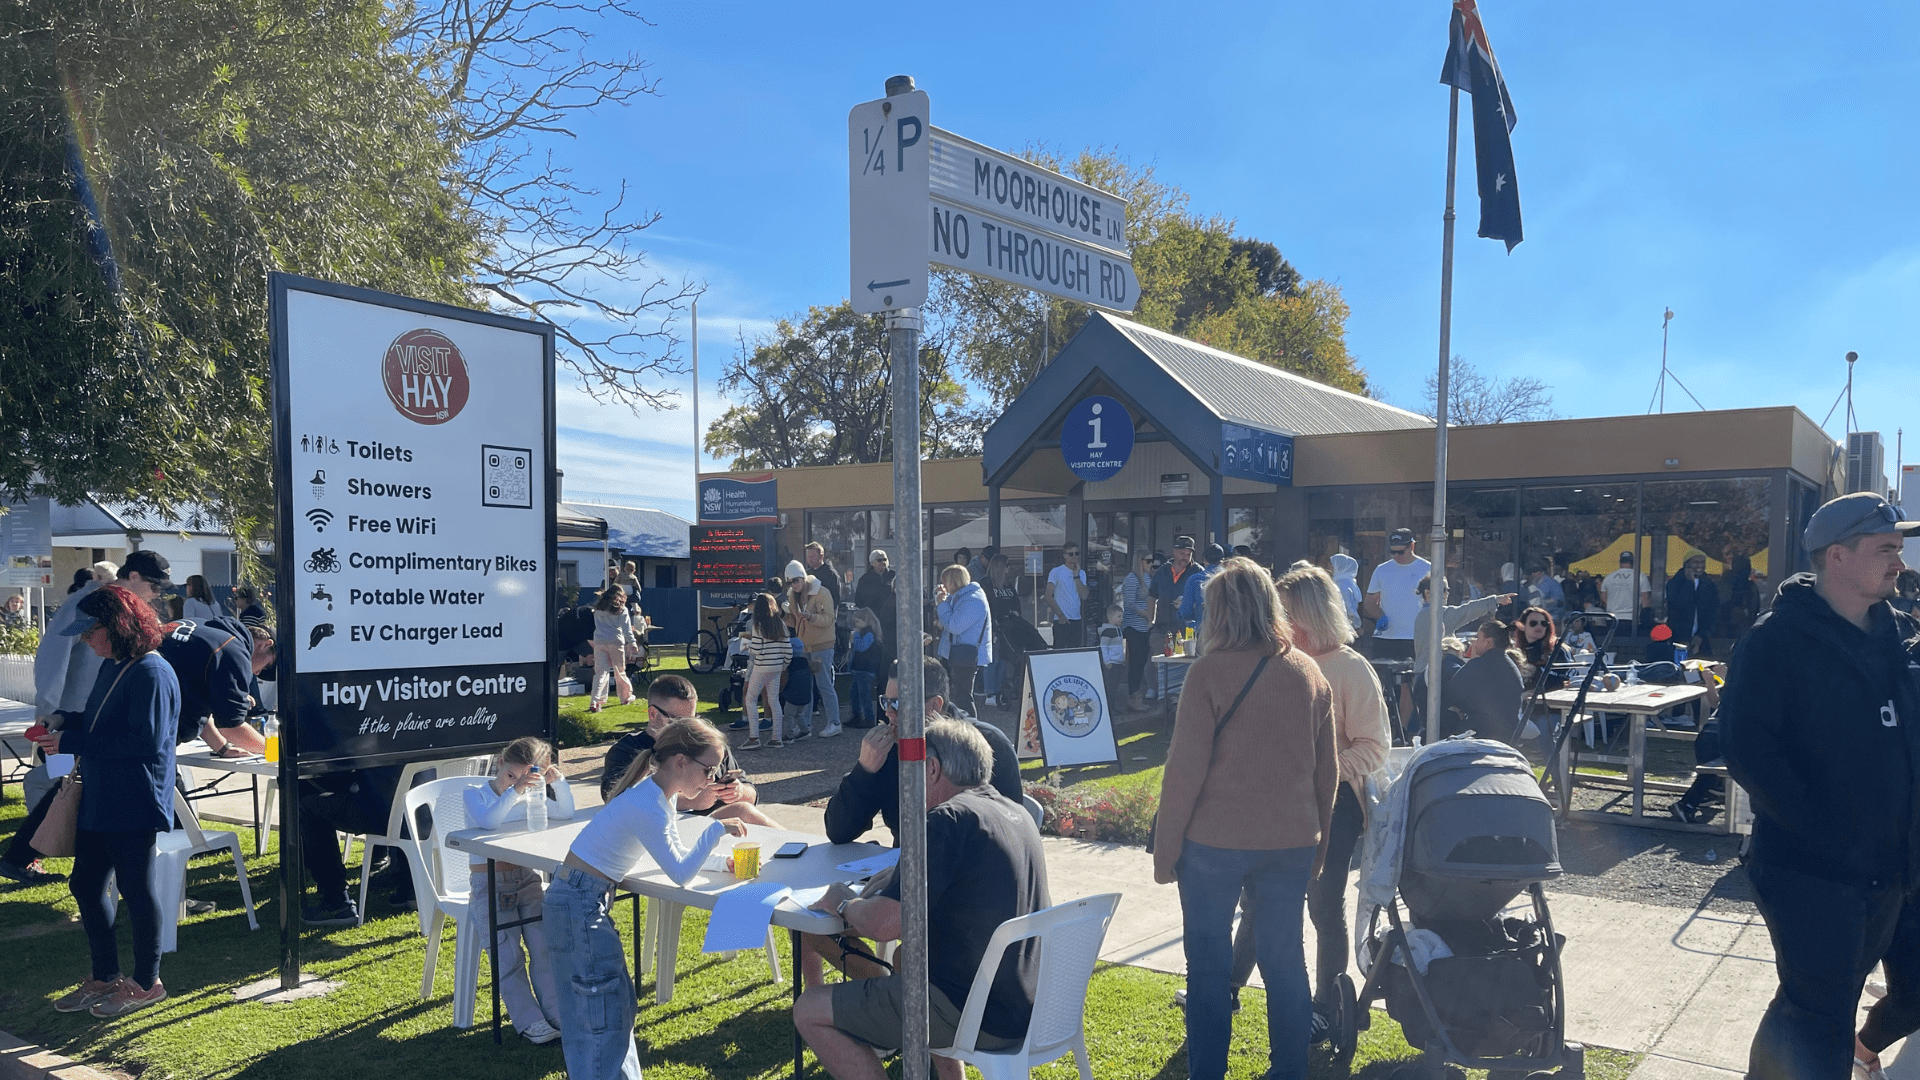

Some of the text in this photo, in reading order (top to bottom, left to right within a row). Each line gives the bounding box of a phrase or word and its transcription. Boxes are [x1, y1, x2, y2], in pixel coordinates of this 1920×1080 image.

[897, 116, 922, 172] P
[974, 157, 1121, 243] MOORHOUSE LN
[933, 207, 1126, 304] NO THROUGH RD
[396, 344, 451, 376] VISIT
[401, 375, 453, 409] HAY
[436, 409, 450, 421] NSW
[346, 440, 414, 463] Toilets
[1089, 451, 1104, 459] HAY
[1070, 460, 1123, 469] VISITOR CENTRE
[347, 478, 432, 500] Showers
[725, 490, 747, 498] Health
[704, 502, 722, 512] NSW
[348, 515, 437, 535] Free WiFi
[349, 551, 537, 576] Complimentary Bikes
[350, 588, 485, 606] Potable Water
[350, 622, 503, 645] EV Charger Lead
[322, 673, 527, 711] Hay Visitor Centre
[1050, 678, 1089, 691] HAY GUIDES
[358, 707, 498, 740] #the plains are calling
